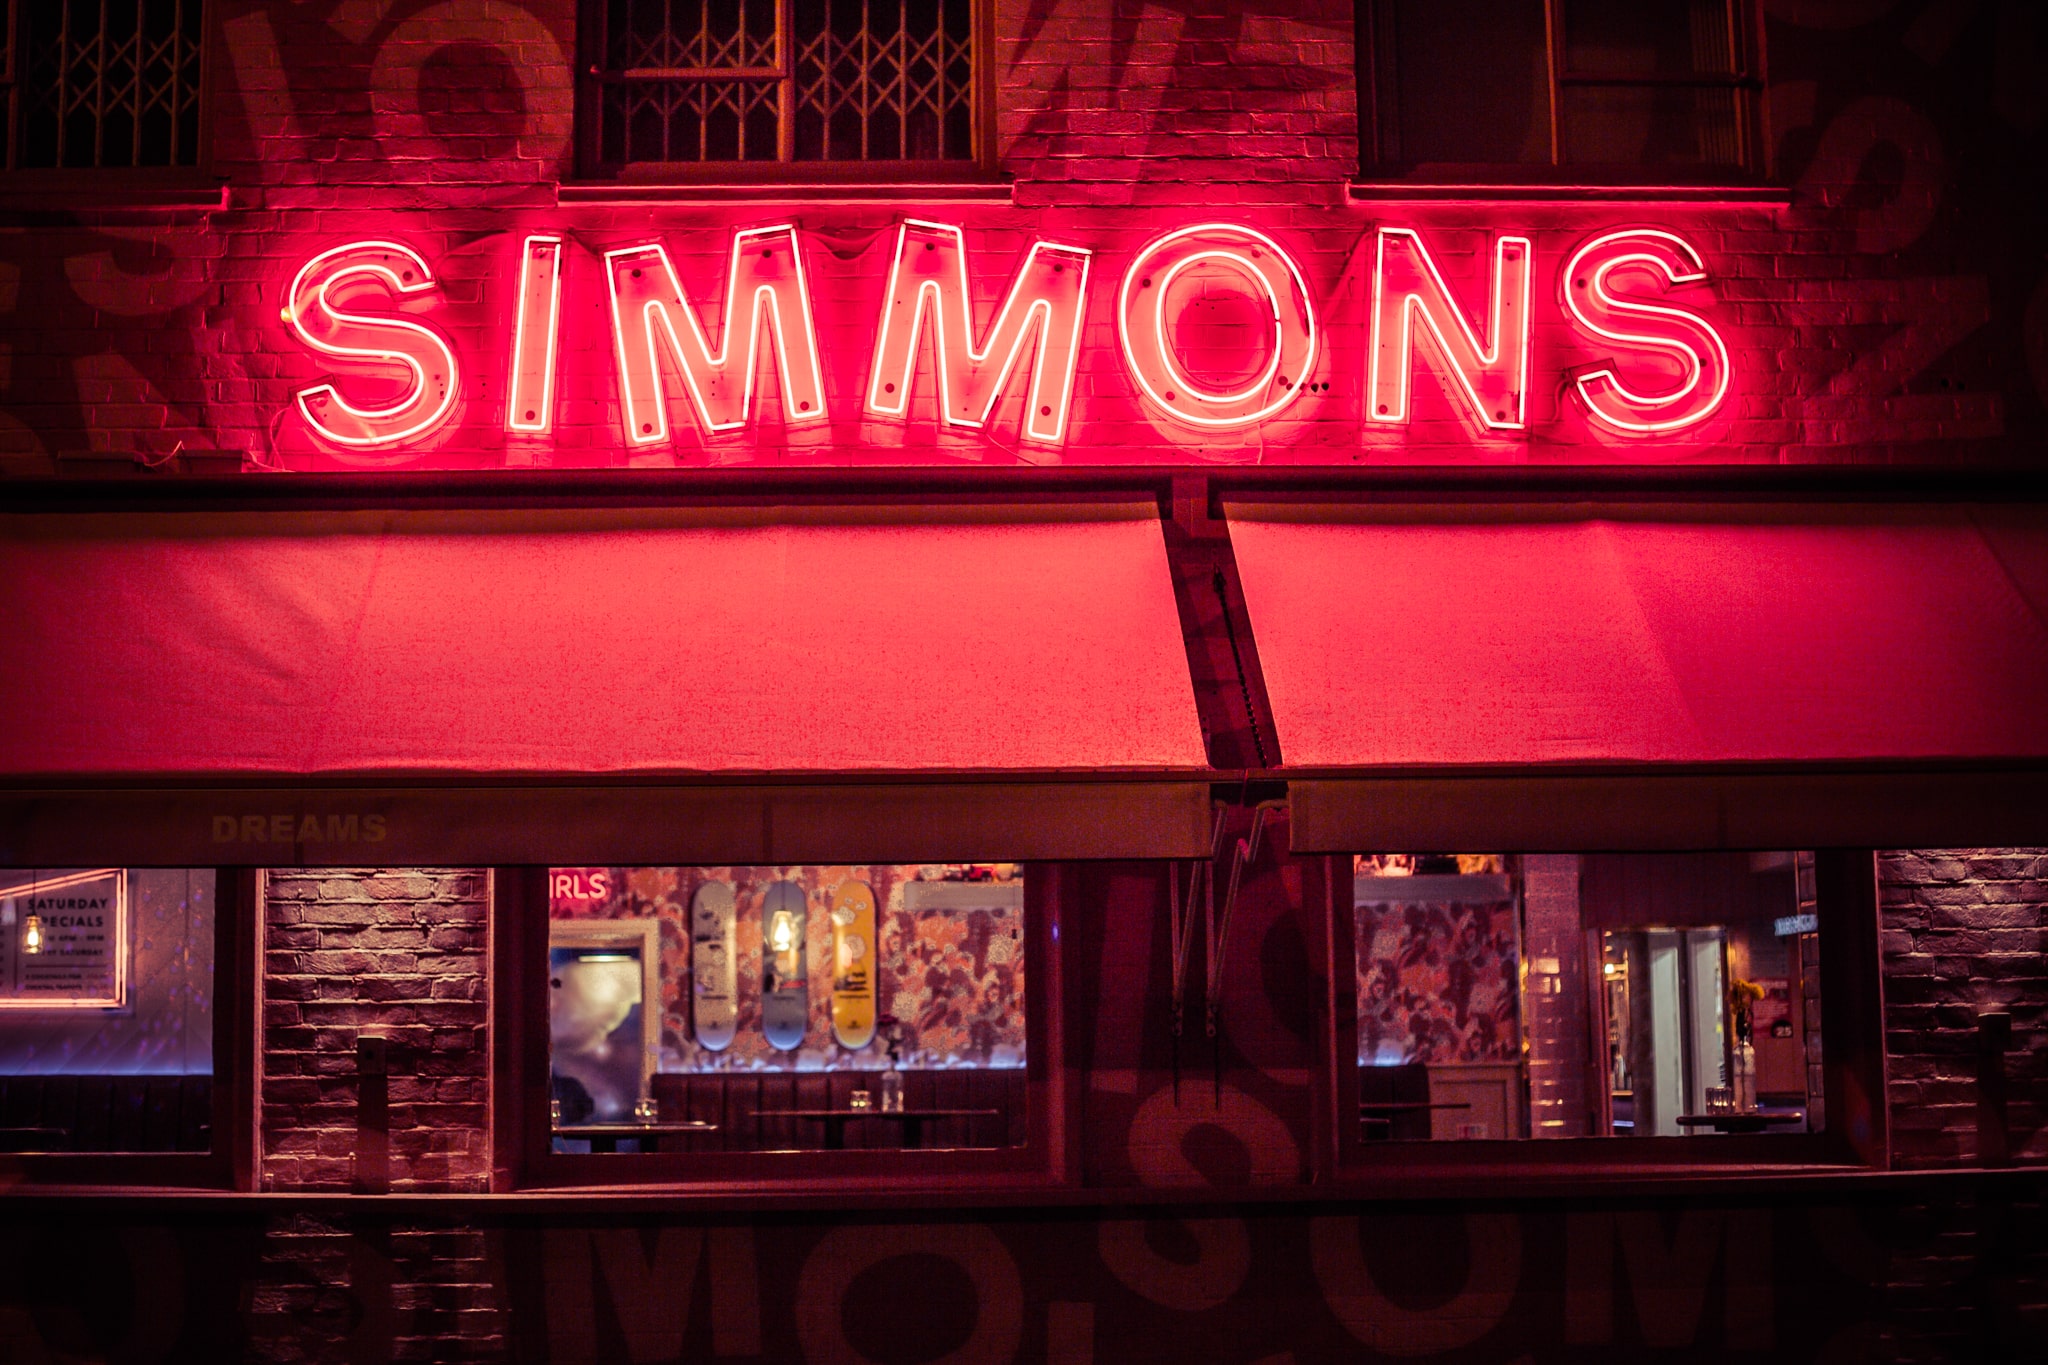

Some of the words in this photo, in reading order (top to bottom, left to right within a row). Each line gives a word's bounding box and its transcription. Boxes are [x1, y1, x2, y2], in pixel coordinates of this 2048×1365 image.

[282, 215, 1733, 449] SIMMONS
[211, 813, 388, 843] DREAMS
[28, 898, 108, 909] SATURDAY
[33, 916, 104, 927] PECIALS
